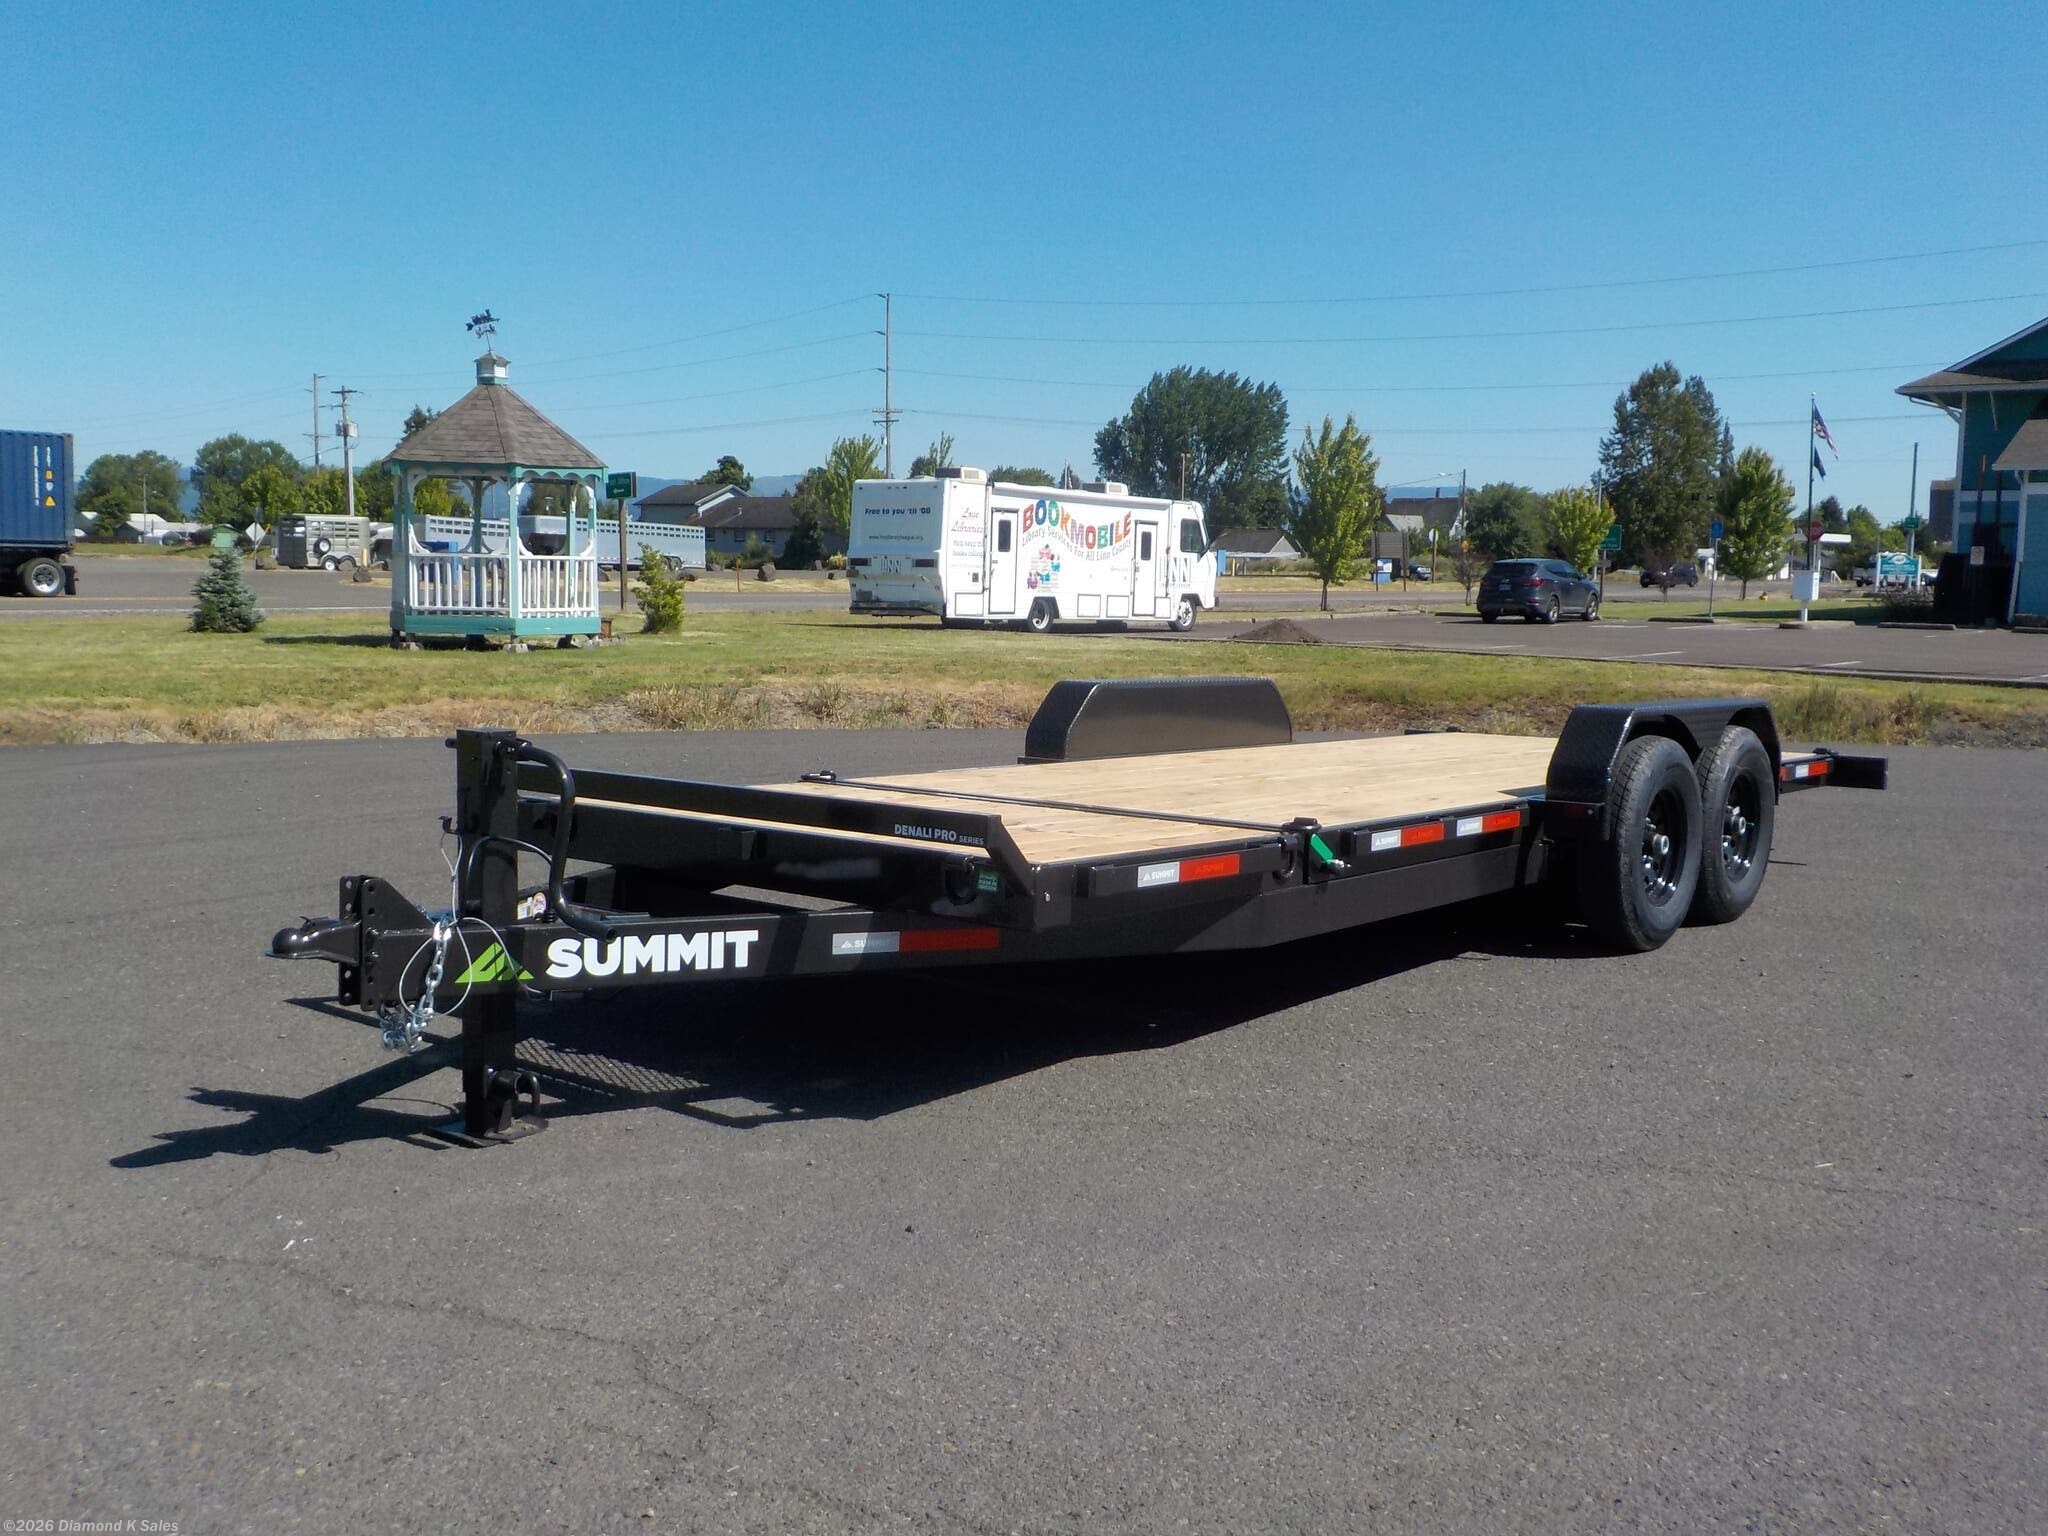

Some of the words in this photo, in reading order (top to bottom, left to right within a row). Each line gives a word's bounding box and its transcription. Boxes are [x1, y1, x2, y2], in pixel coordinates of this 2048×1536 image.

[892, 508, 905, 516] you
[1022, 500, 1131, 550] BOOKMOBILE
[1022, 527, 1046, 548] Library
[1047, 526, 1073, 553] Services
[894, 823, 932, 839] DENALI
[934, 828, 957, 841] PRO
[959, 835, 984, 845] SERIES
[545, 929, 759, 978] SUMMIT
